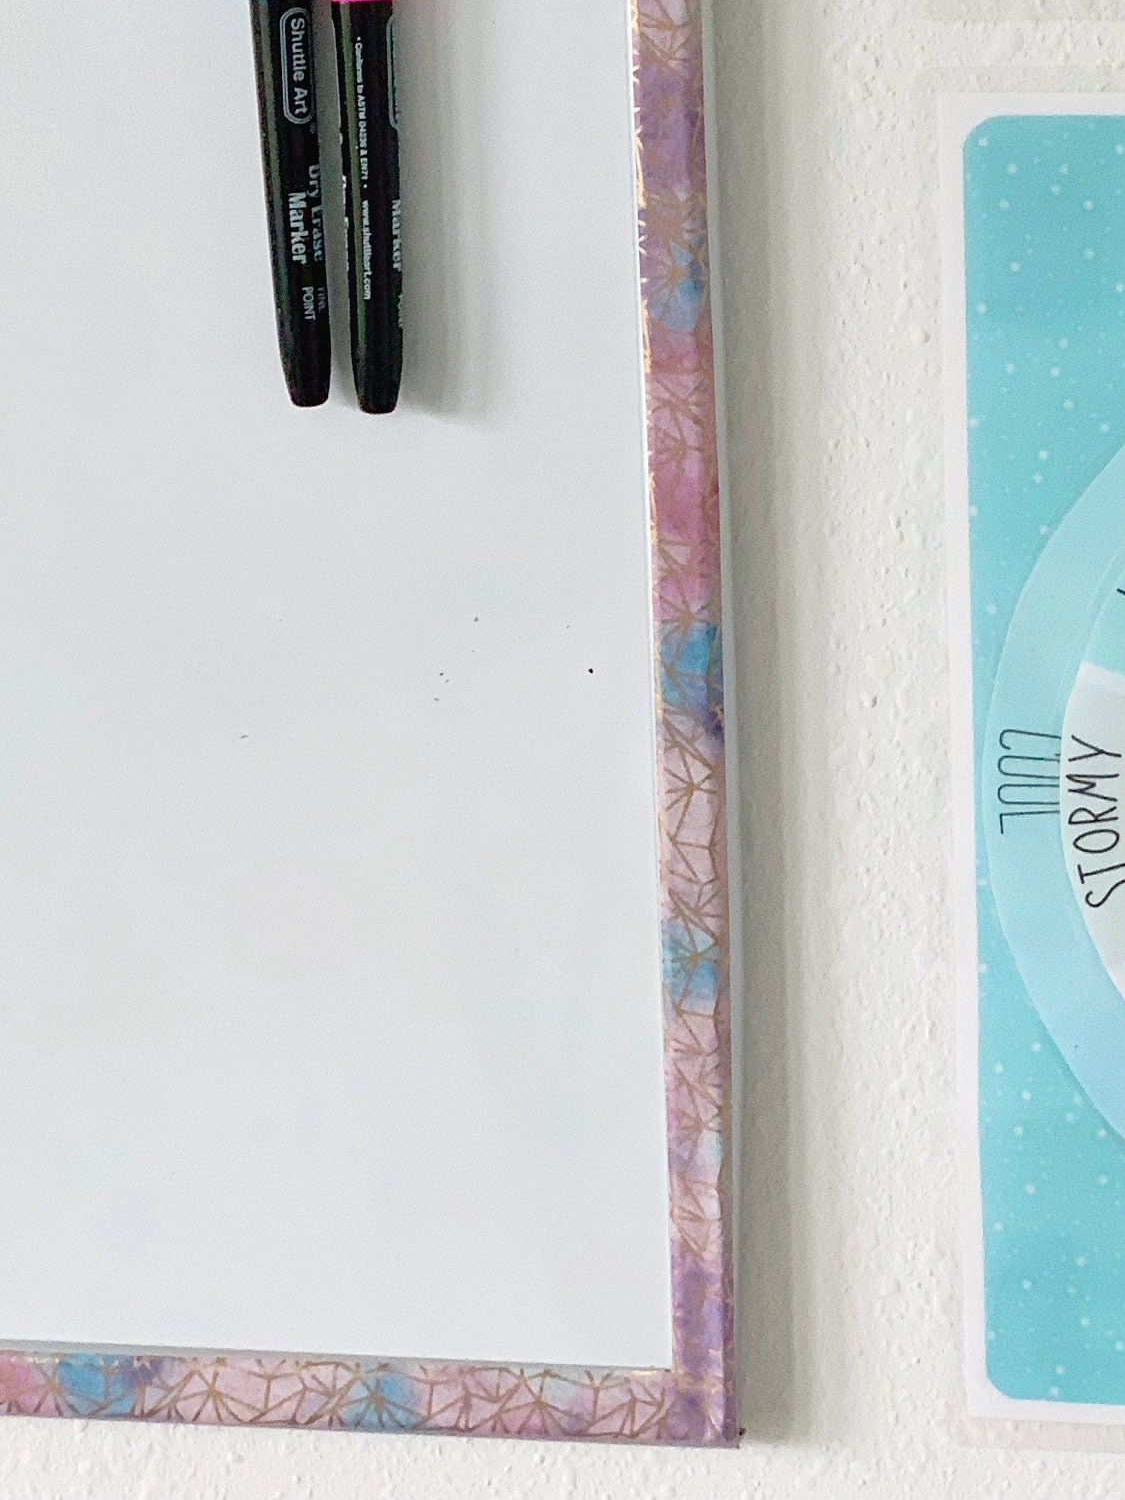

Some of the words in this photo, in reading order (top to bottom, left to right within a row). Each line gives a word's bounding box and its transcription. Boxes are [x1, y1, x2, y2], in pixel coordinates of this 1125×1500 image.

[290, 17, 307, 82] Shuttle
[294, 87, 308, 114] Art
[288, 191, 309, 265] Marker
[301, 286, 316, 321] POINT
